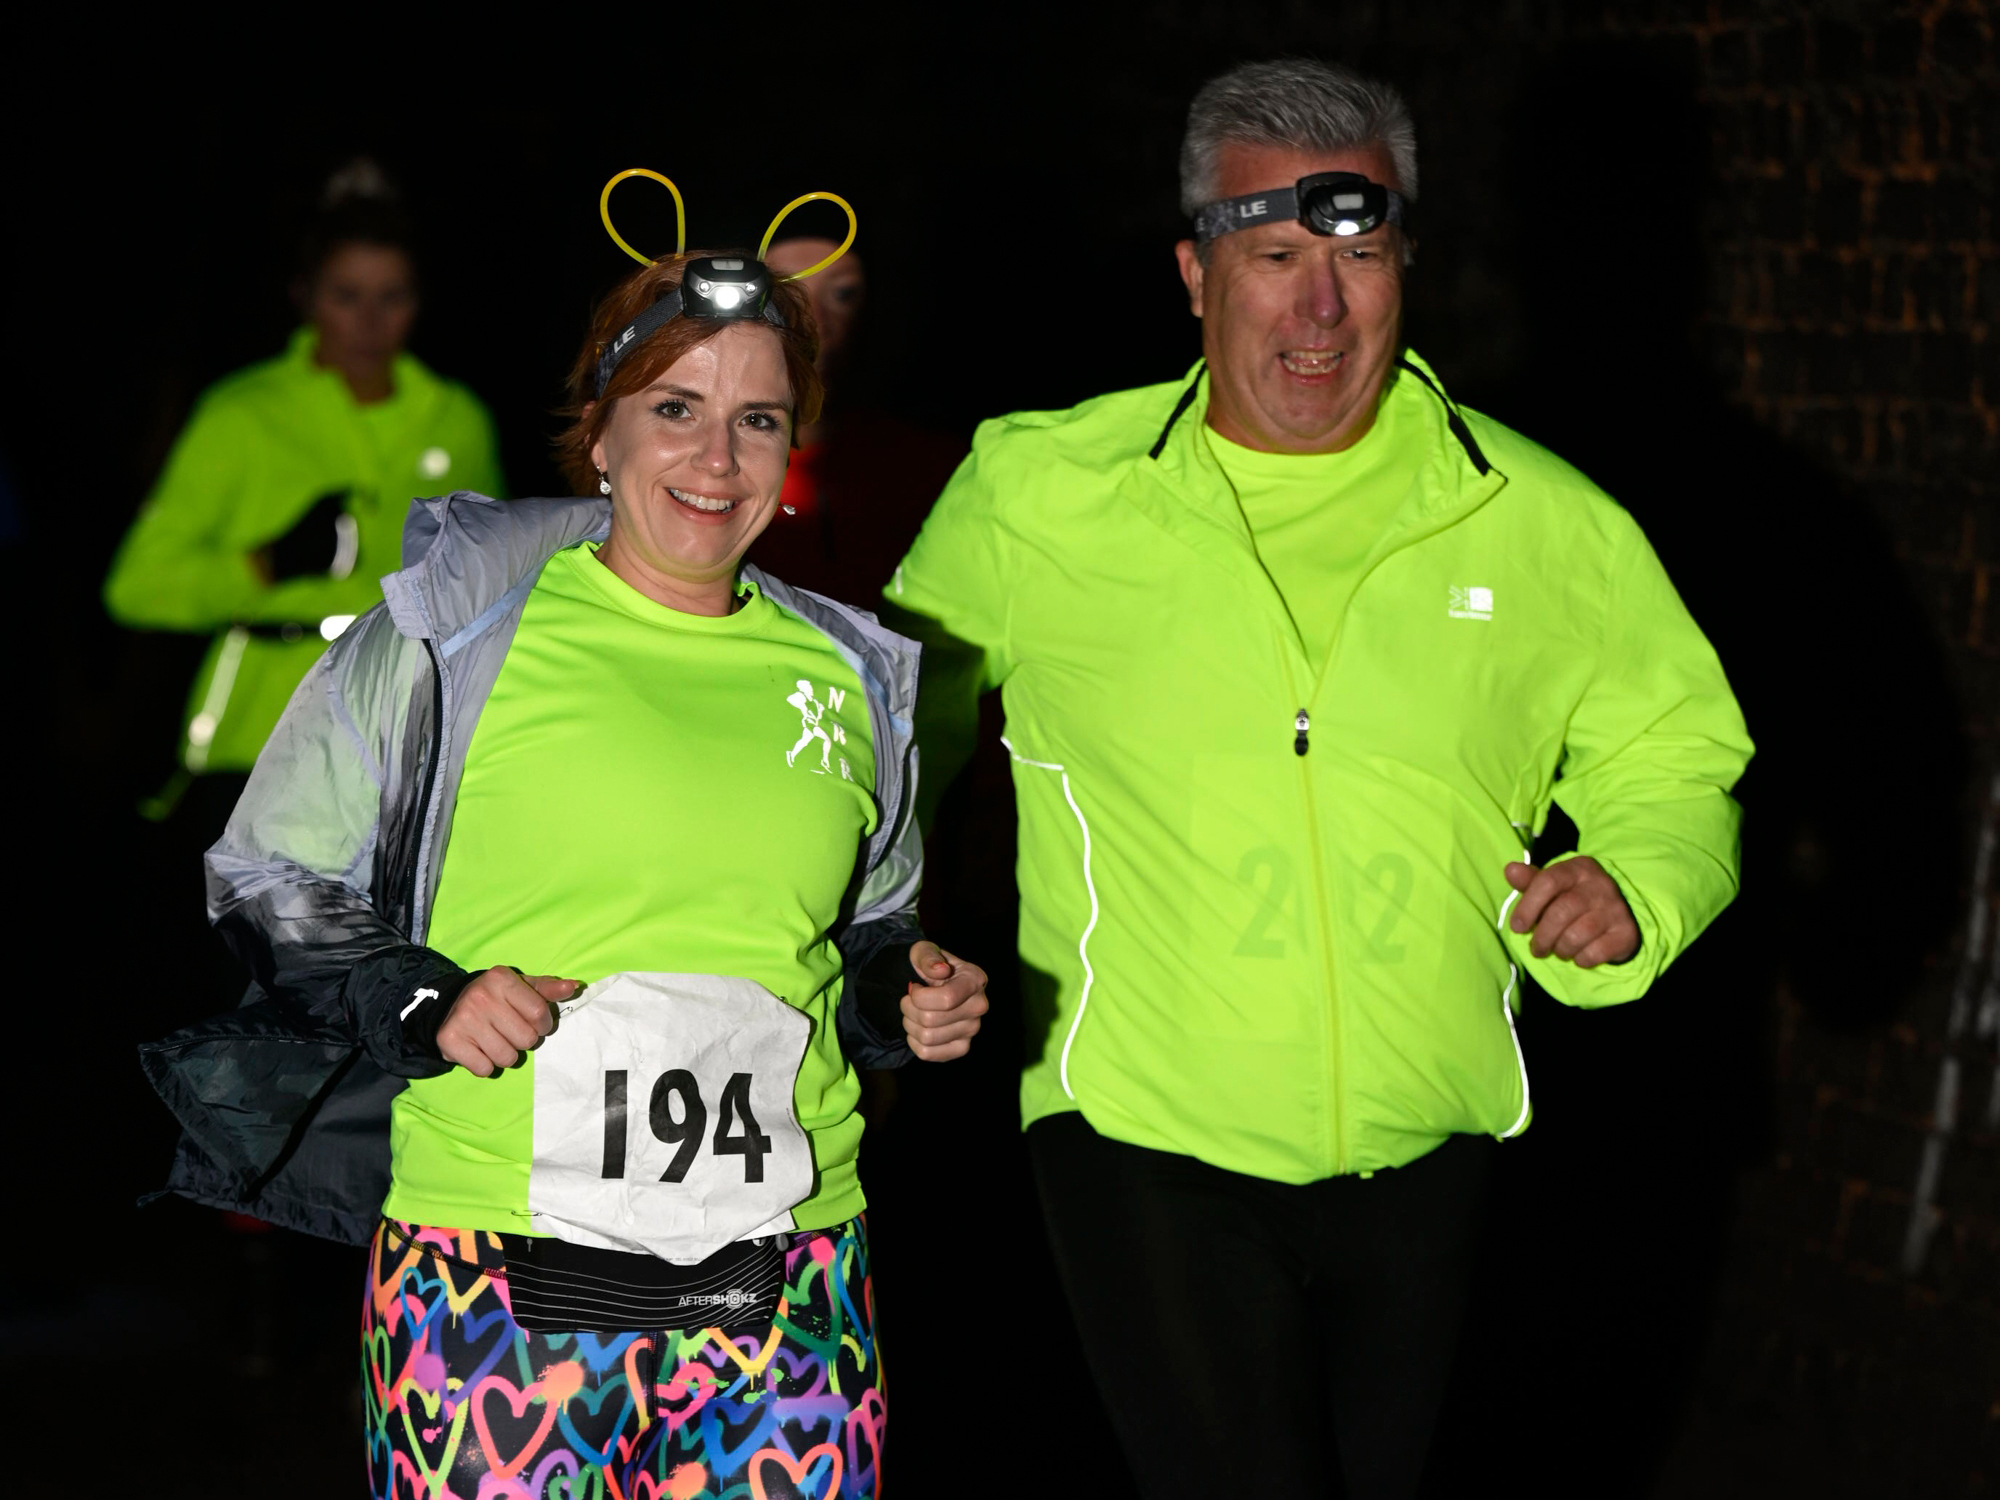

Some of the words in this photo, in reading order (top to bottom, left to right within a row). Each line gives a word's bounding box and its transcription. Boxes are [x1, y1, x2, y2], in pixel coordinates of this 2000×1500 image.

[1240, 200, 1268, 219] LE
[613, 325, 636, 354] LE
[1232, 845, 1415, 965] 22
[601, 1068, 773, 1184] 194
[678, 1291, 758, 1308] AFTERSHOKZ
